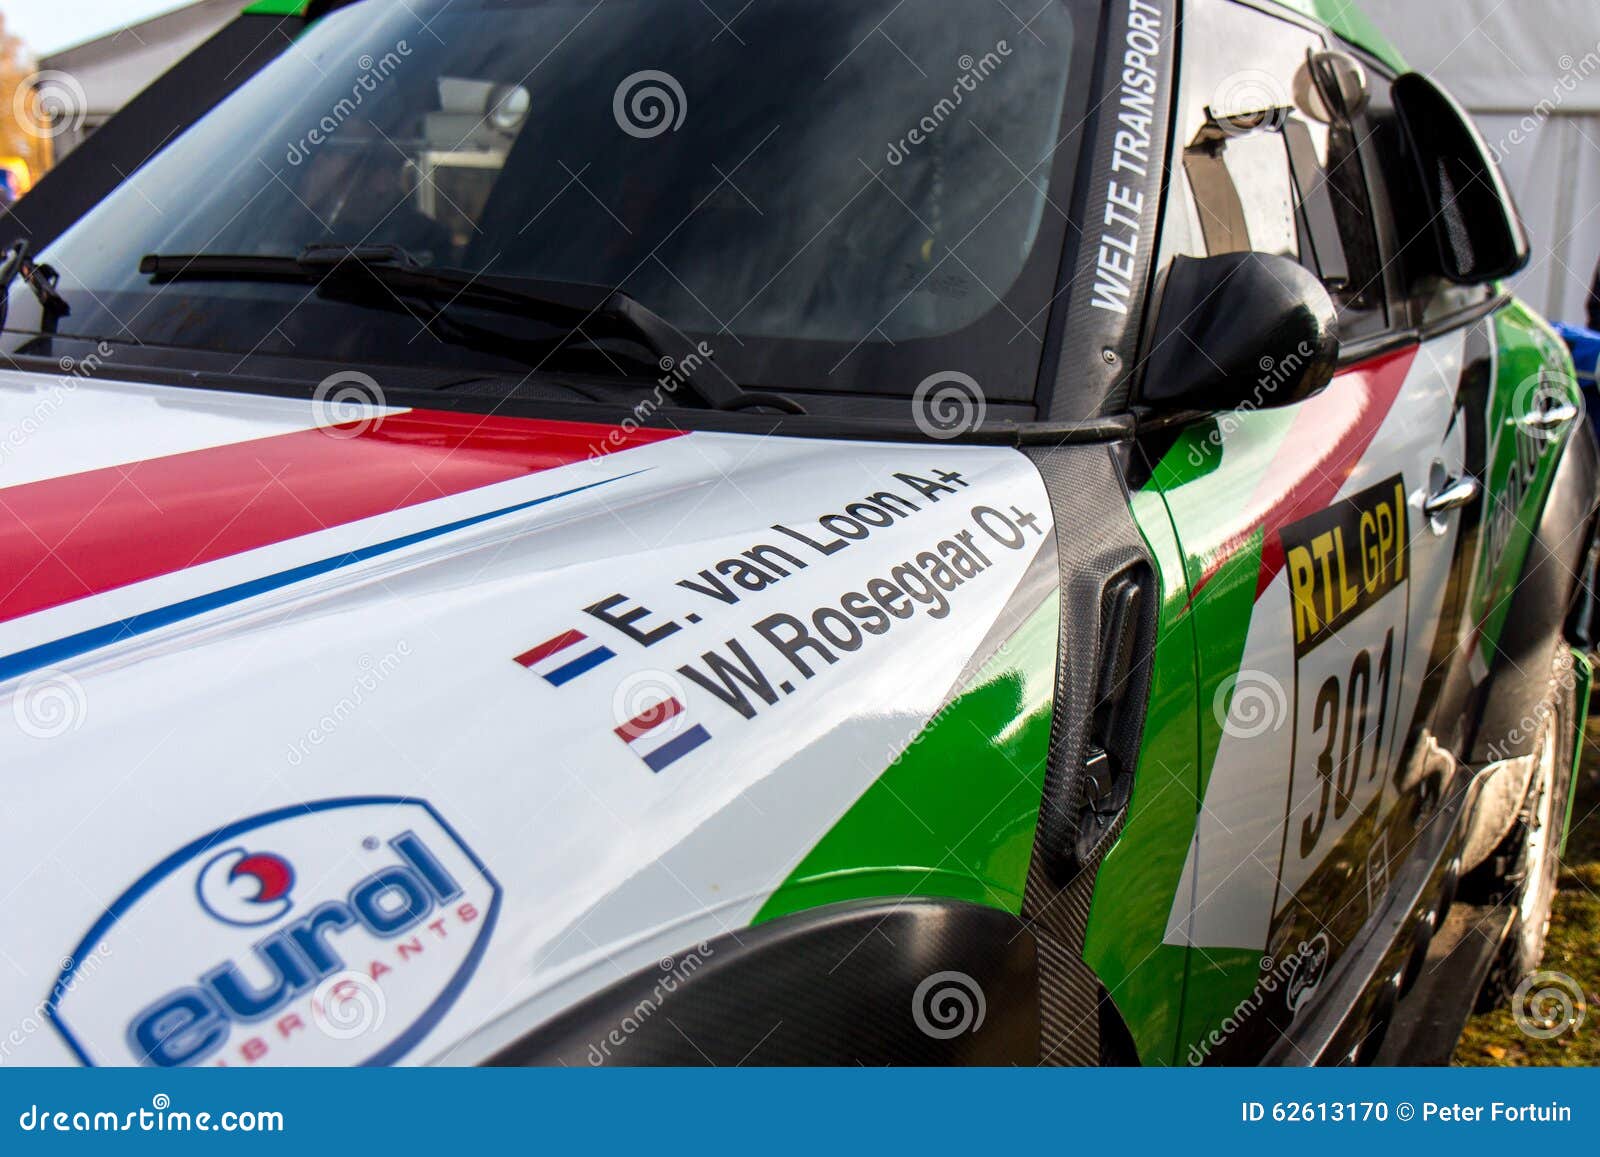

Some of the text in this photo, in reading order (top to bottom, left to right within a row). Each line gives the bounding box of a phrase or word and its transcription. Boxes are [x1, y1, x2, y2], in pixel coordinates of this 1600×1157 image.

[1091, 0, 1162, 315] WELTE TRANSPORT
[582, 468, 969, 648] E. van Loon A+
[970, 504, 1043, 550] O+
[1288, 526, 1358, 644] RTL
[1300, 626, 1394, 859] 301
[125, 829, 465, 1067] eurol
[217, 903, 479, 1067] BRICANTS
